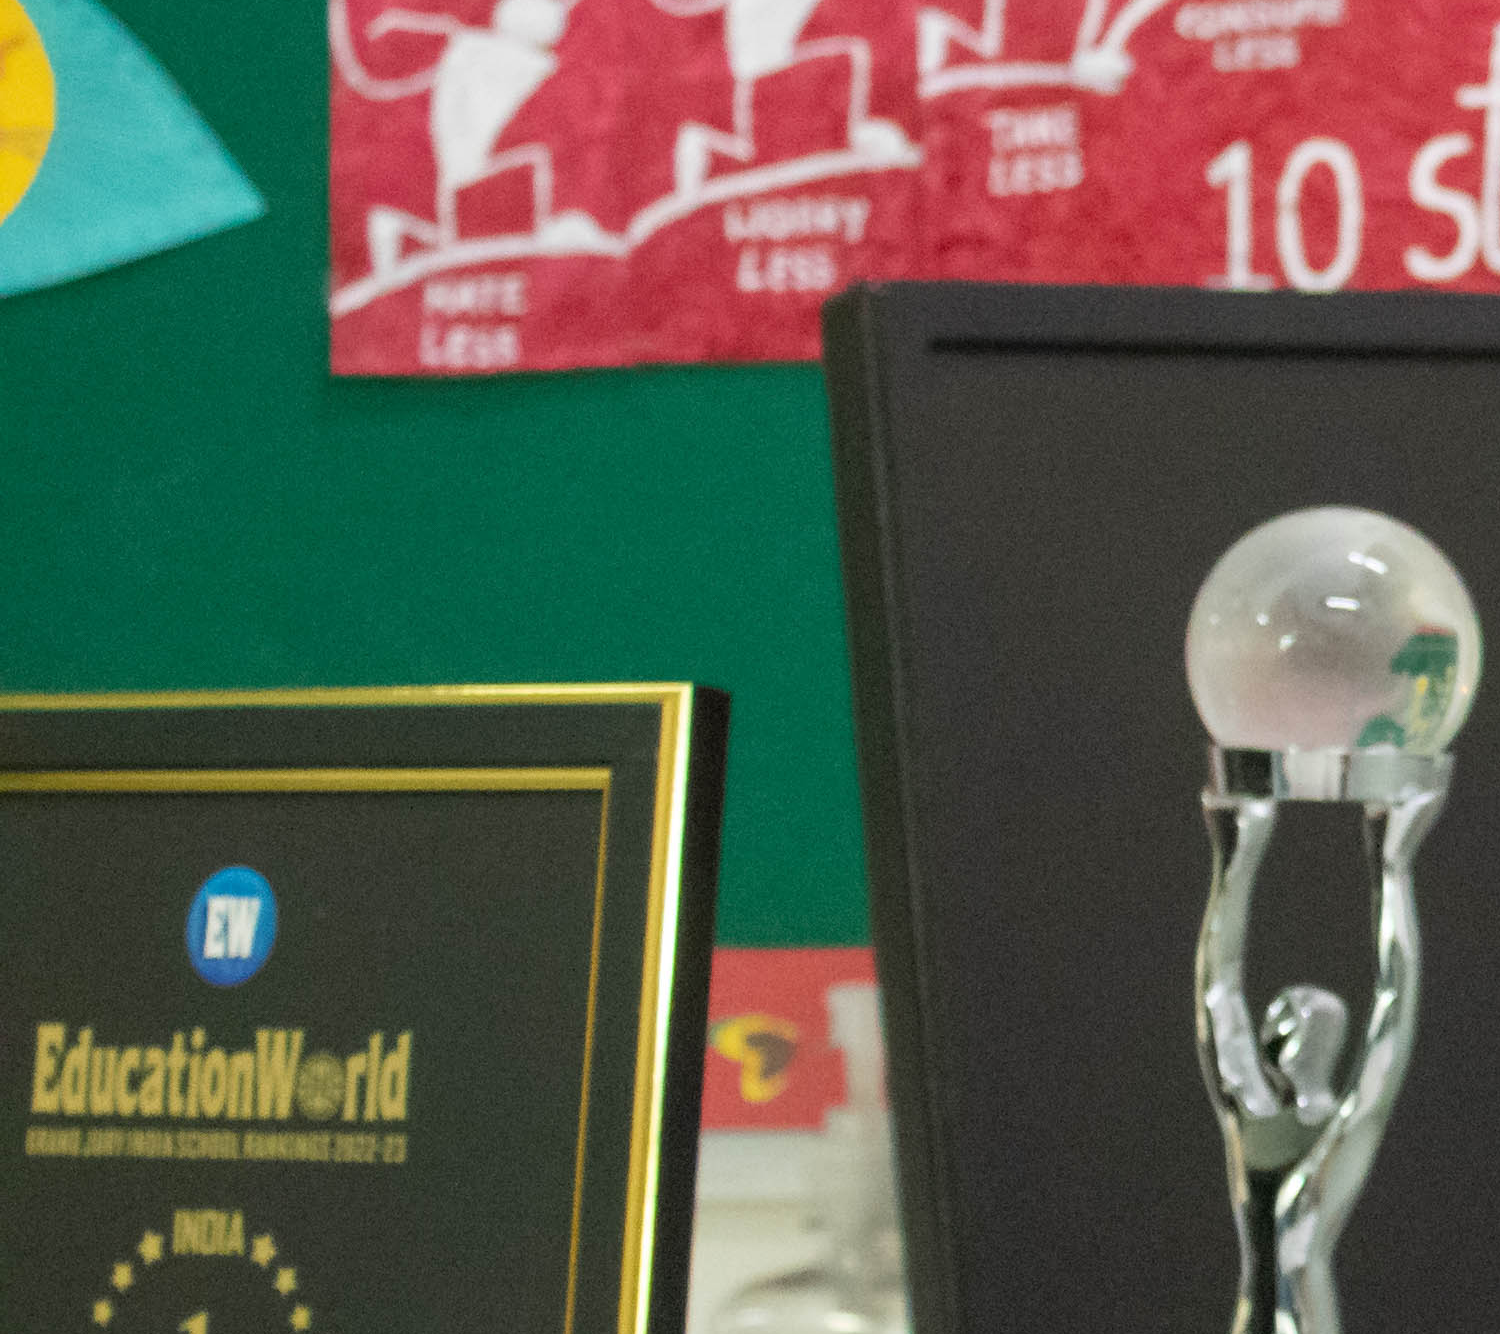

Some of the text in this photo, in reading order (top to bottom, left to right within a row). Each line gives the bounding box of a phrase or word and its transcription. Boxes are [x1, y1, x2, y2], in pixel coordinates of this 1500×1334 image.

[1212, 32, 1298, 72] LESS
[988, 151, 1083, 196] LESS
[724, 198, 868, 242] WORRY
[1206, 136, 1364, 293] 10
[736, 248, 835, 293] LESS
[421, 274, 529, 316] HATE
[419, 325, 522, 369] LESS
[203, 896, 260, 959] EW
[31, 1023, 412, 1121] EducationWorld
[173, 1210, 244, 1257] INDIA
